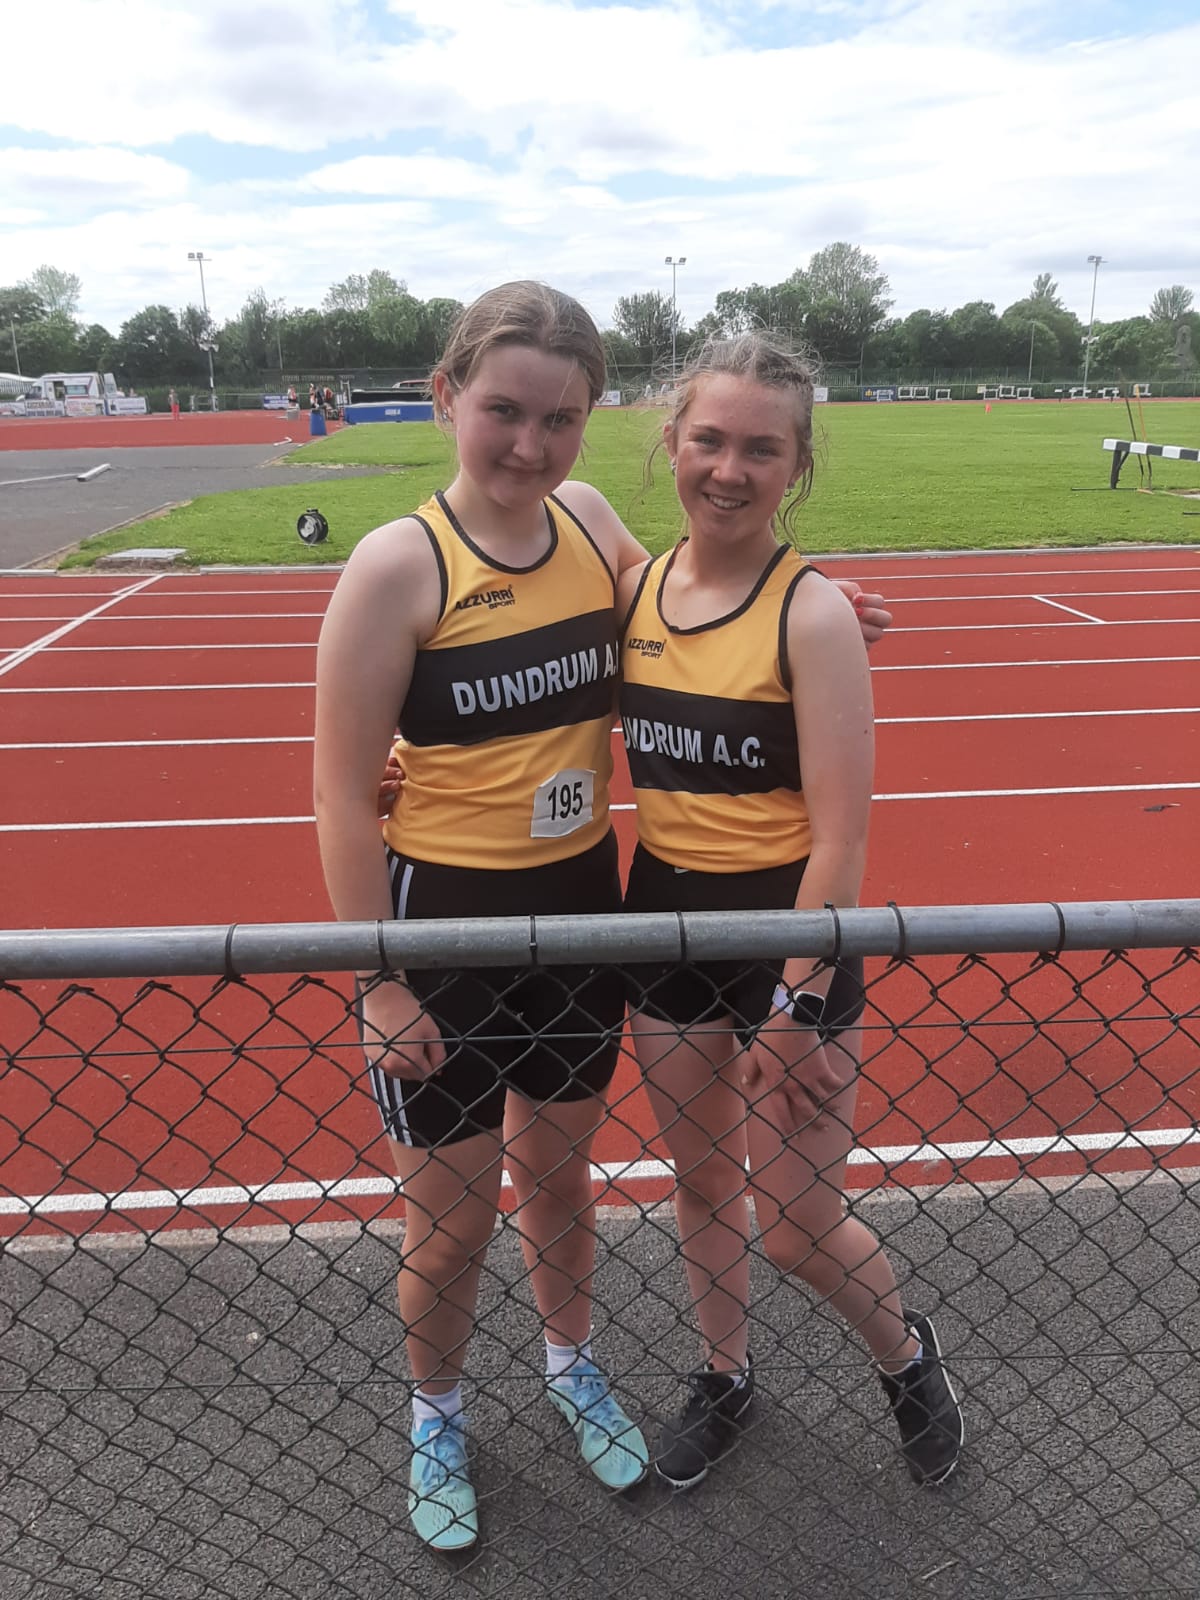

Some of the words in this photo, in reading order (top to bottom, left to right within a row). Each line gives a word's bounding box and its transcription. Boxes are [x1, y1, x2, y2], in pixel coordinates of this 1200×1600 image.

[453, 588, 514, 611] AZZURRI
[488, 599, 516, 609] SPORT
[641, 651, 661, 659] SPORT
[452, 648, 598, 715] DUNDRUM
[712, 734, 766, 768] A.C.
[548, 781, 583, 821] 195
